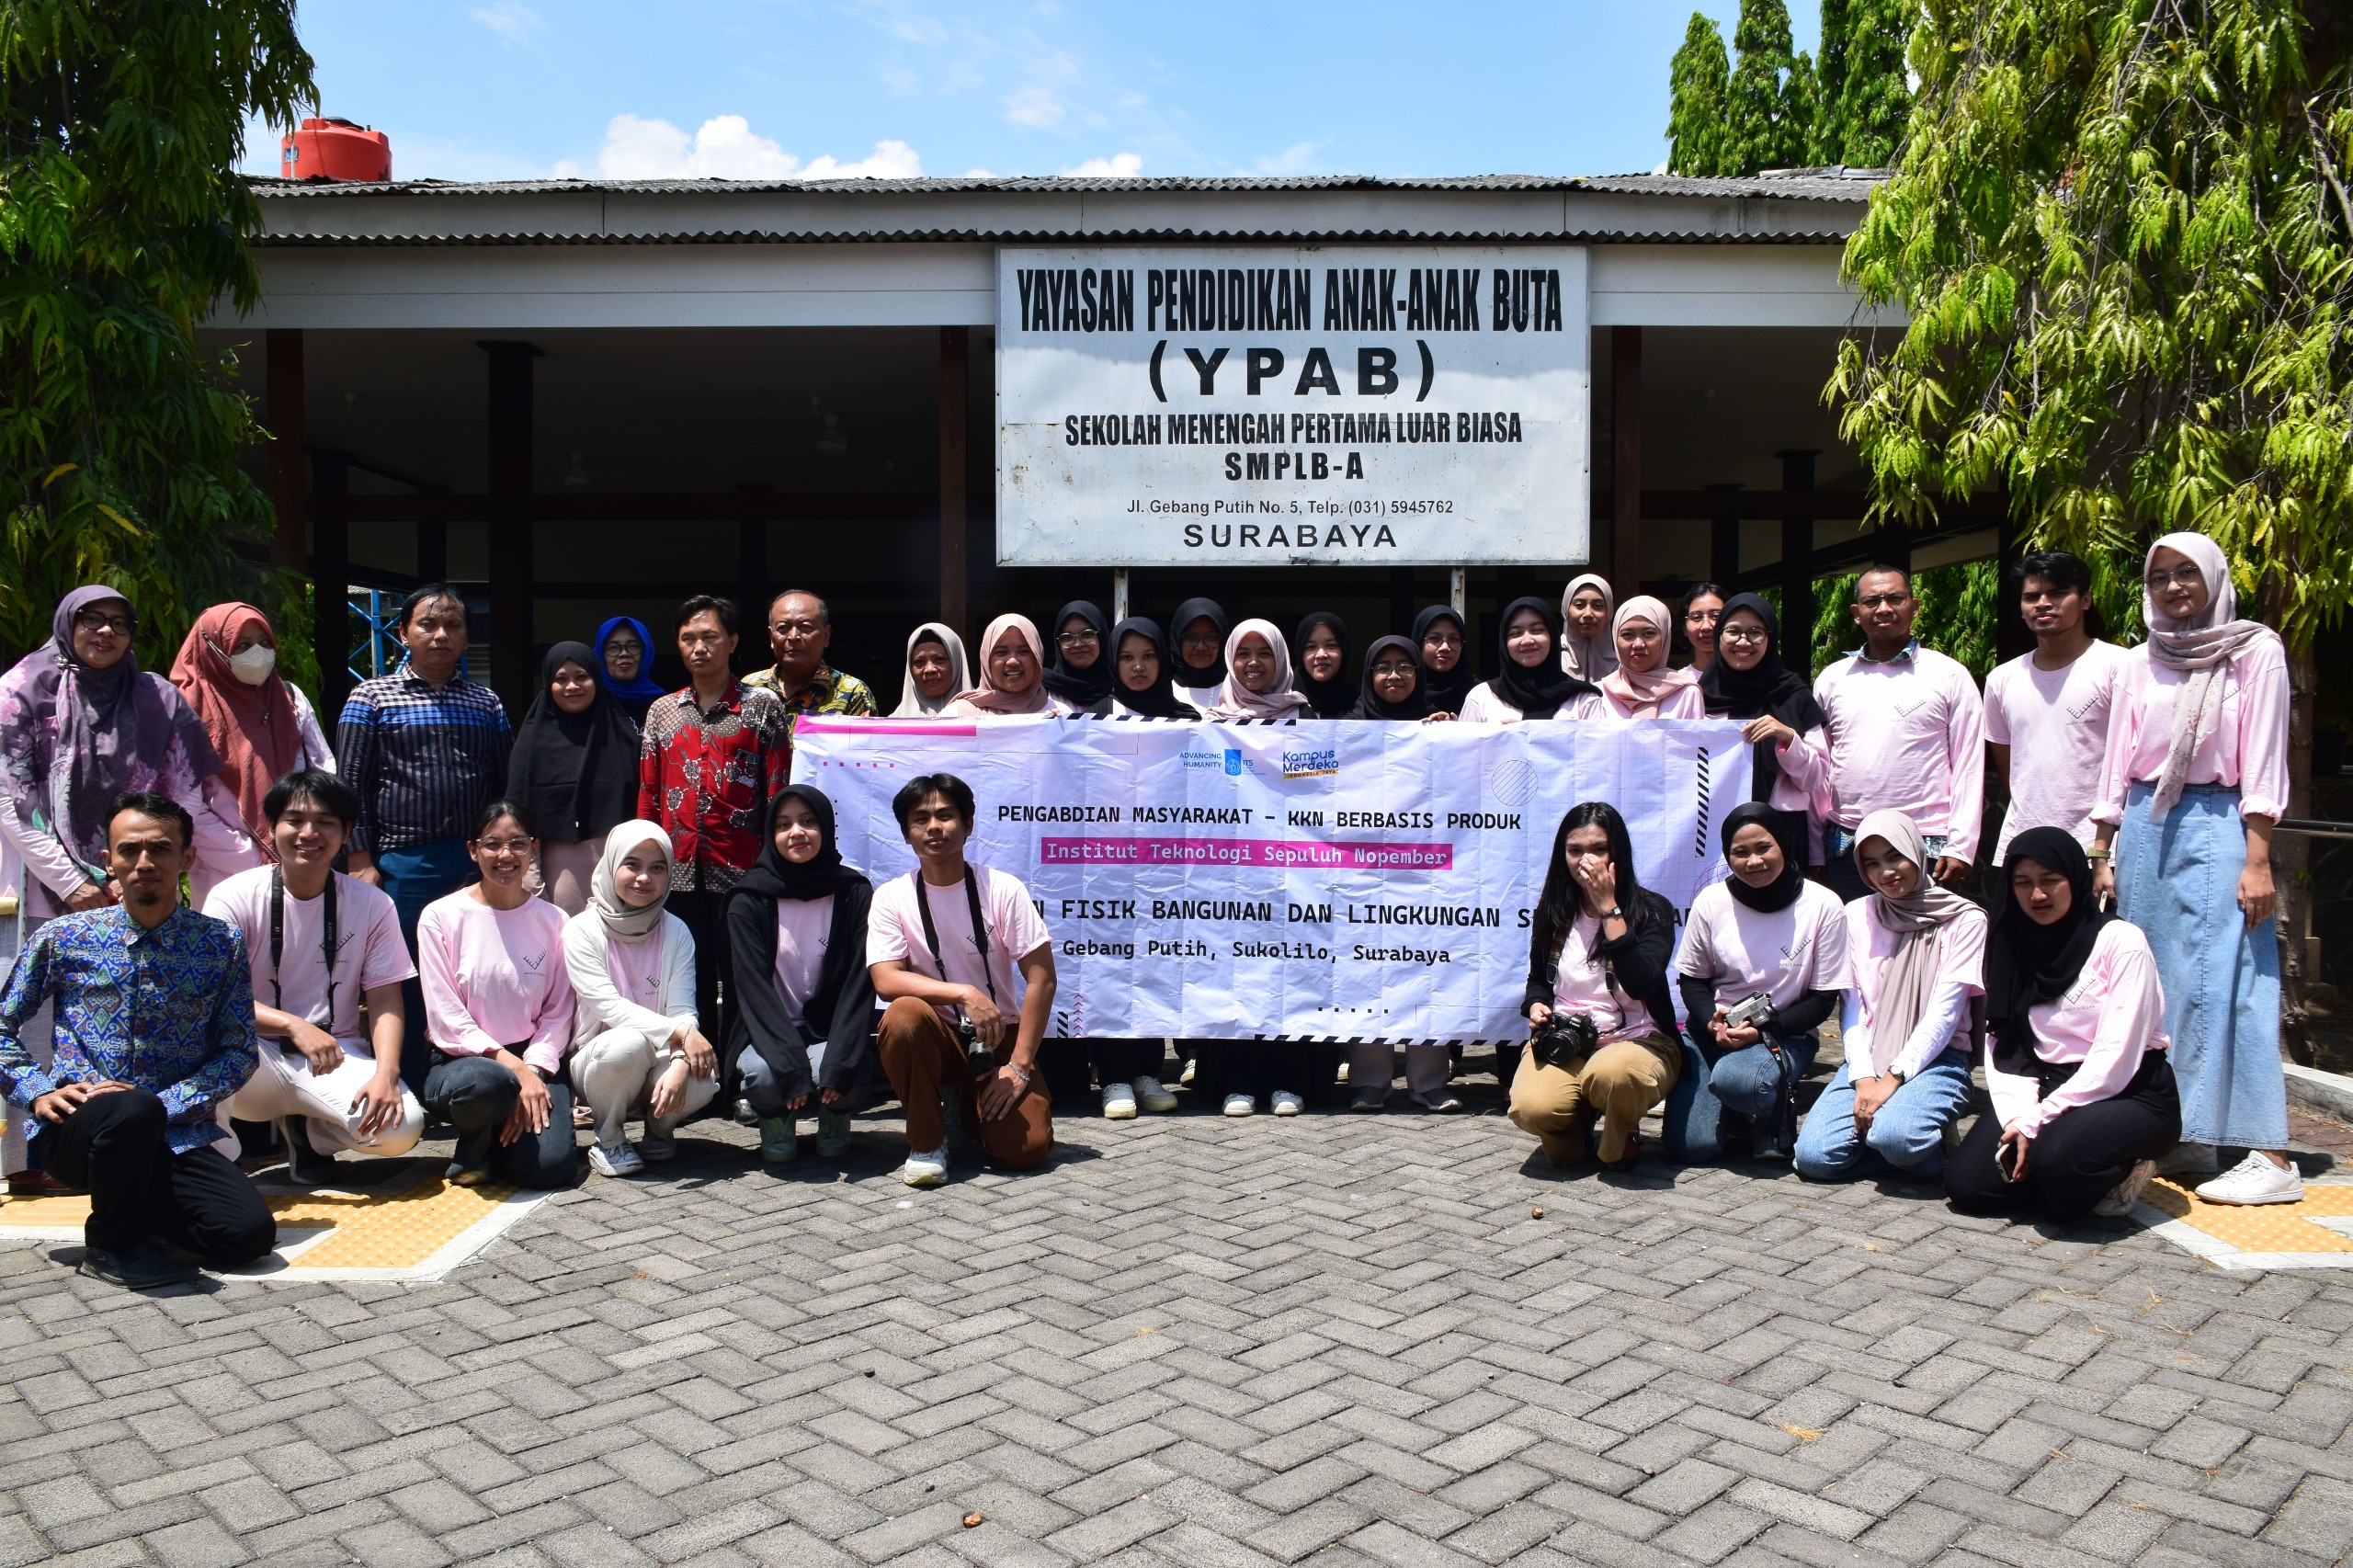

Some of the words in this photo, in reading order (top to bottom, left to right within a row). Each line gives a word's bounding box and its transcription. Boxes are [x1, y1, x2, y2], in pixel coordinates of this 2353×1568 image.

[1017, 267, 1134, 333] YAYASAN
[1147, 268, 1311, 332] PENDIDIKAN
[1324, 268, 1481, 332] ANAK-ANAK
[1493, 268, 1563, 333] BUTA
[1065, 414, 1162, 447] SEKOLAH
[1167, 413, 1285, 445] MENENGAH
[1290, 413, 1392, 444] PERTAMA
[1396, 412, 1450, 444] LUAR
[1457, 411, 1522, 443] BIASA
[1224, 451, 1364, 482] SMPLB-A
[1127, 499, 1145, 514] Jl.
[1150, 499, 1210, 517] Gebang
[1214, 499, 1255, 514] Putih
[1259, 500, 1285, 514] No.
[1290, 500, 1302, 517] 5,
[1308, 500, 1343, 517] Telp.
[1348, 500, 1386, 517] (031)
[1391, 500, 1453, 514] 5945762
[1183, 524, 1397, 548] SURABAYA
[1283, 749, 1336, 763] Kampus
[1283, 758, 1339, 773] Merdeka
[998, 805, 1120, 823] PENGABDIAN
[1132, 805, 1254, 825] MASYARAKAT
[1288, 811, 1324, 827] KKN
[1336, 812, 1434, 829] BERBASIS
[1447, 812, 1521, 830] PRODUK
[1047, 843, 1138, 859] Institut
[1150, 843, 1253, 864] Teknologi
[1264, 846, 1342, 867] Sepuluh
[1354, 847, 1447, 867] Nopember
[1062, 900, 1136, 919] FISIK
[1152, 900, 1271, 922] BANGUNAN
[1288, 903, 1332, 924] DAN
[1348, 903, 1500, 927] LINGKUNGAN
[1063, 938, 1134, 960] Gebang
[1148, 939, 1216, 962] Putih,
[1233, 940, 1336, 964] Sukolilo,
[1353, 943, 1450, 967] Surabaya
